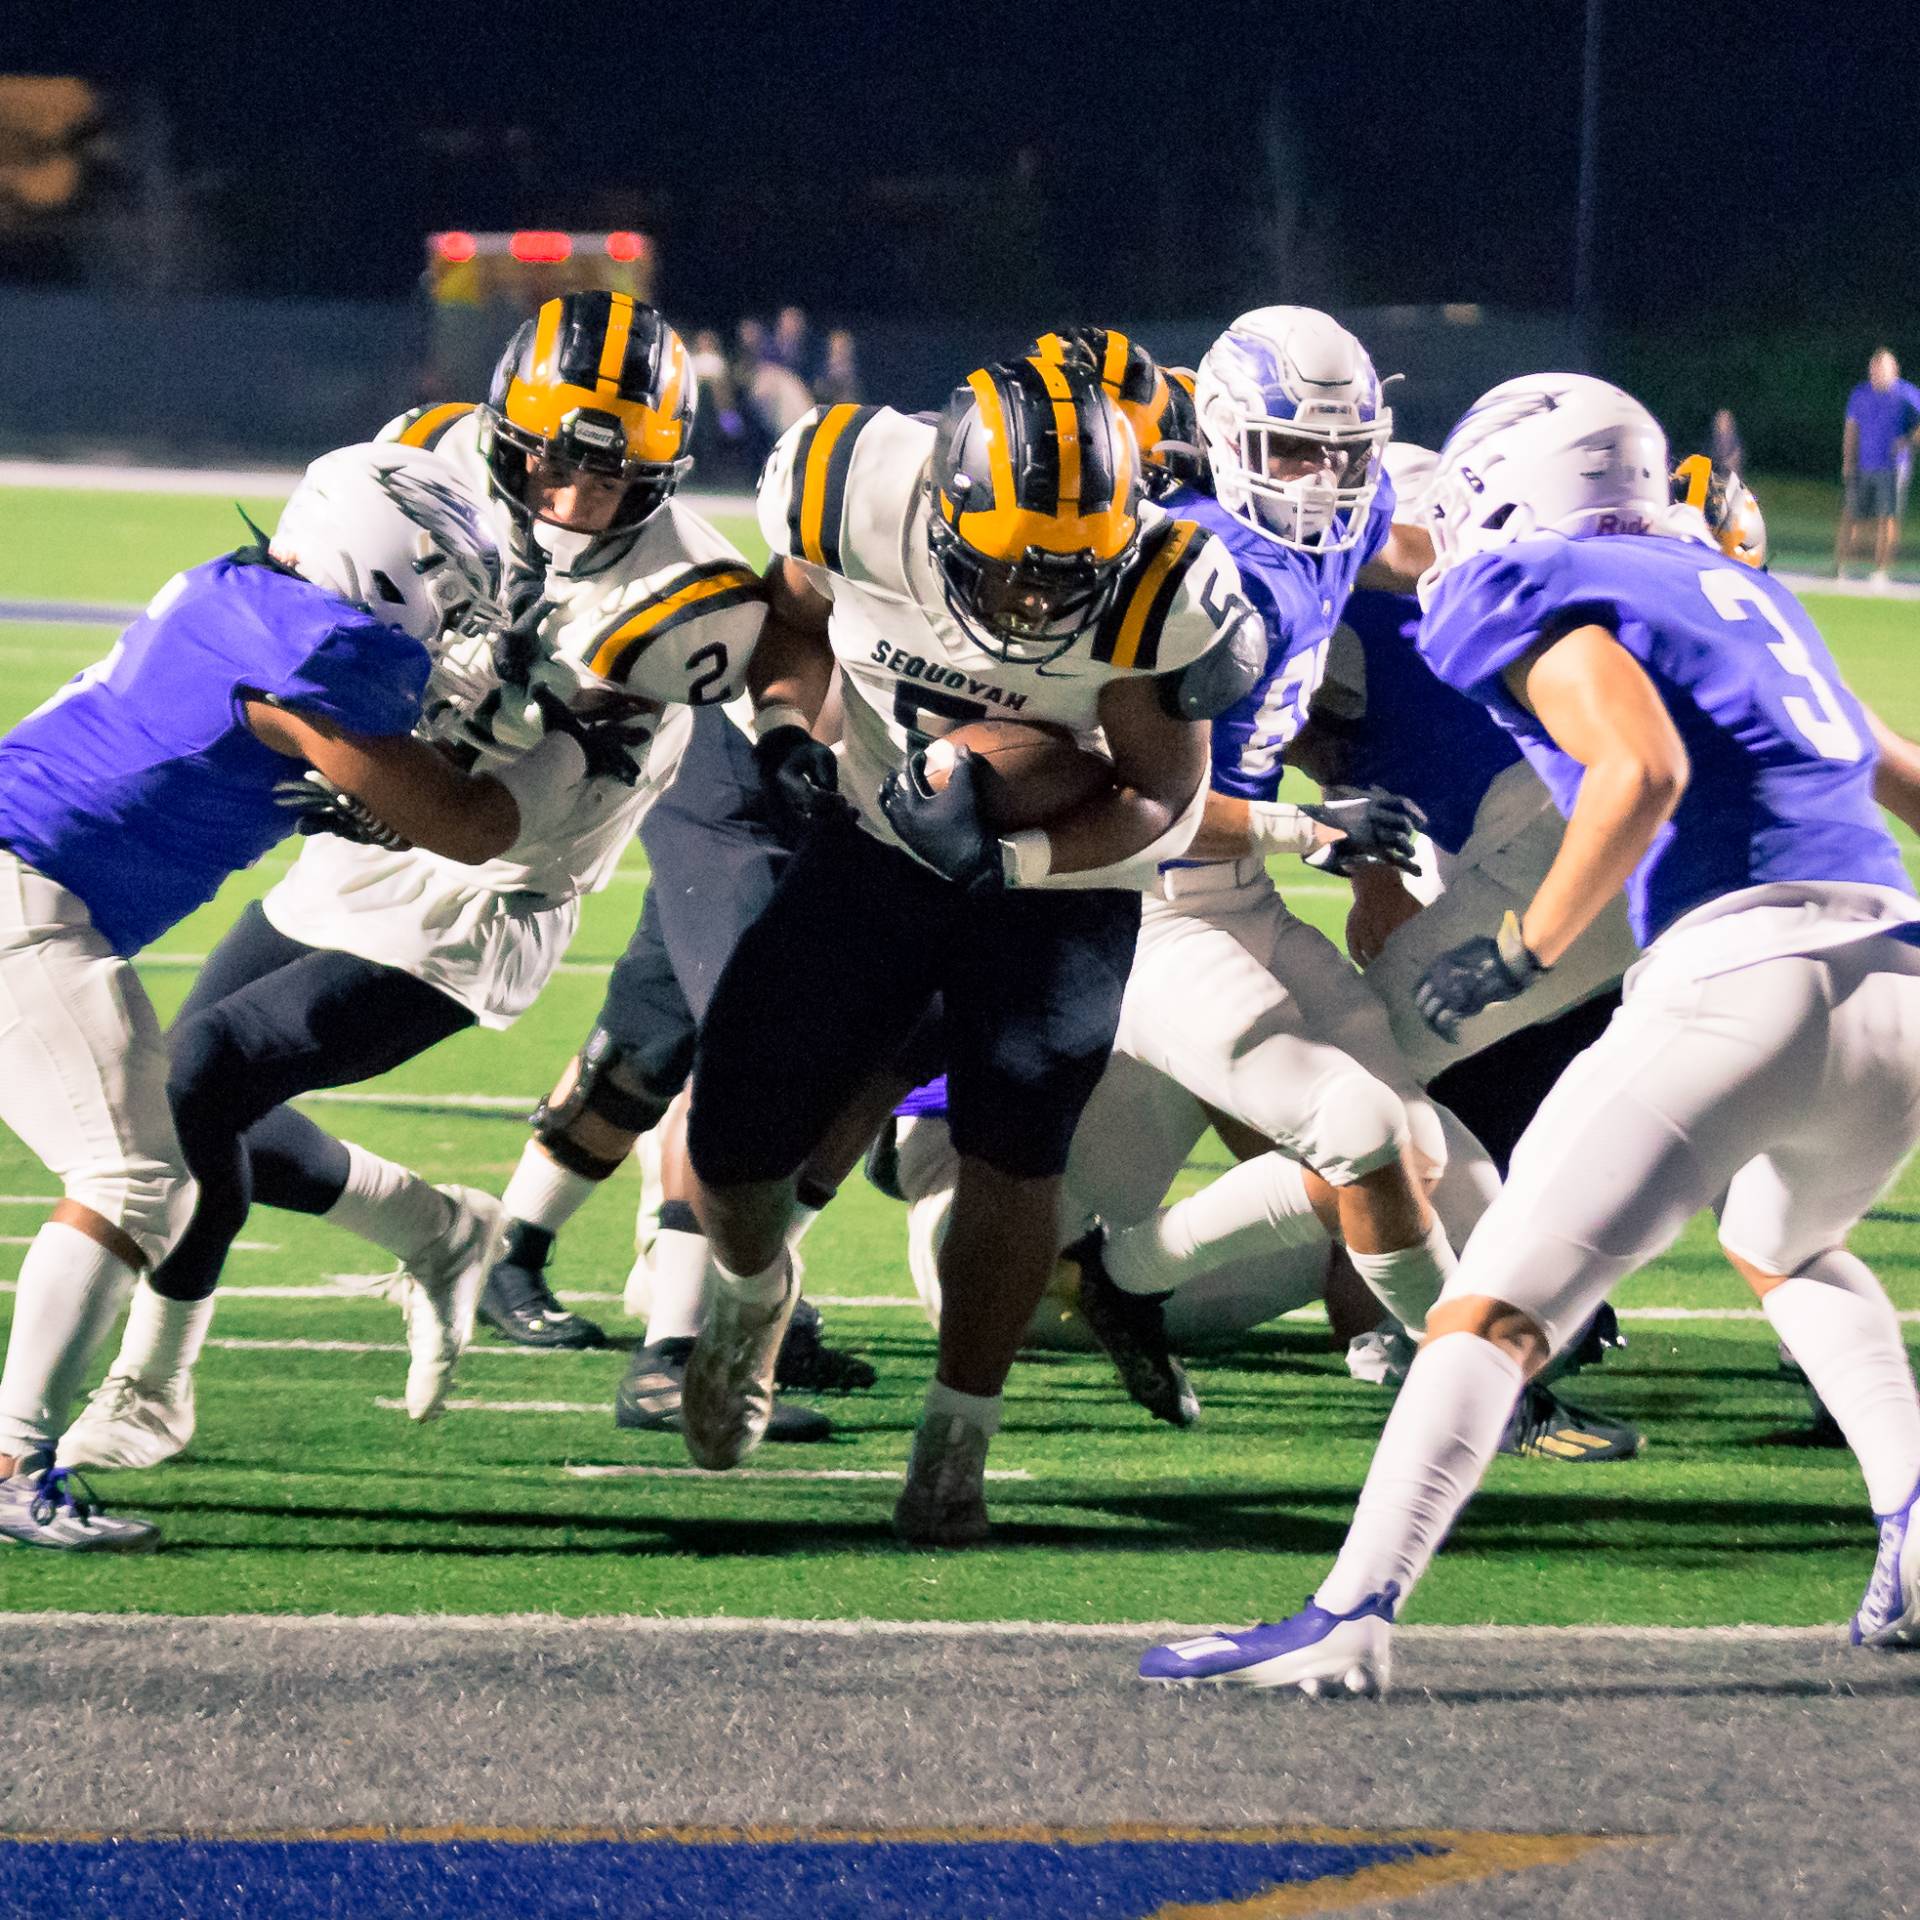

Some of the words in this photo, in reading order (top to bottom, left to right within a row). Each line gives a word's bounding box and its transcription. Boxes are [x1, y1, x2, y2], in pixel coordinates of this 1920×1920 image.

[684, 641, 732, 706] 2
[870, 639, 1029, 711] SEQUOYAH
[1697, 568, 1862, 762] 3
